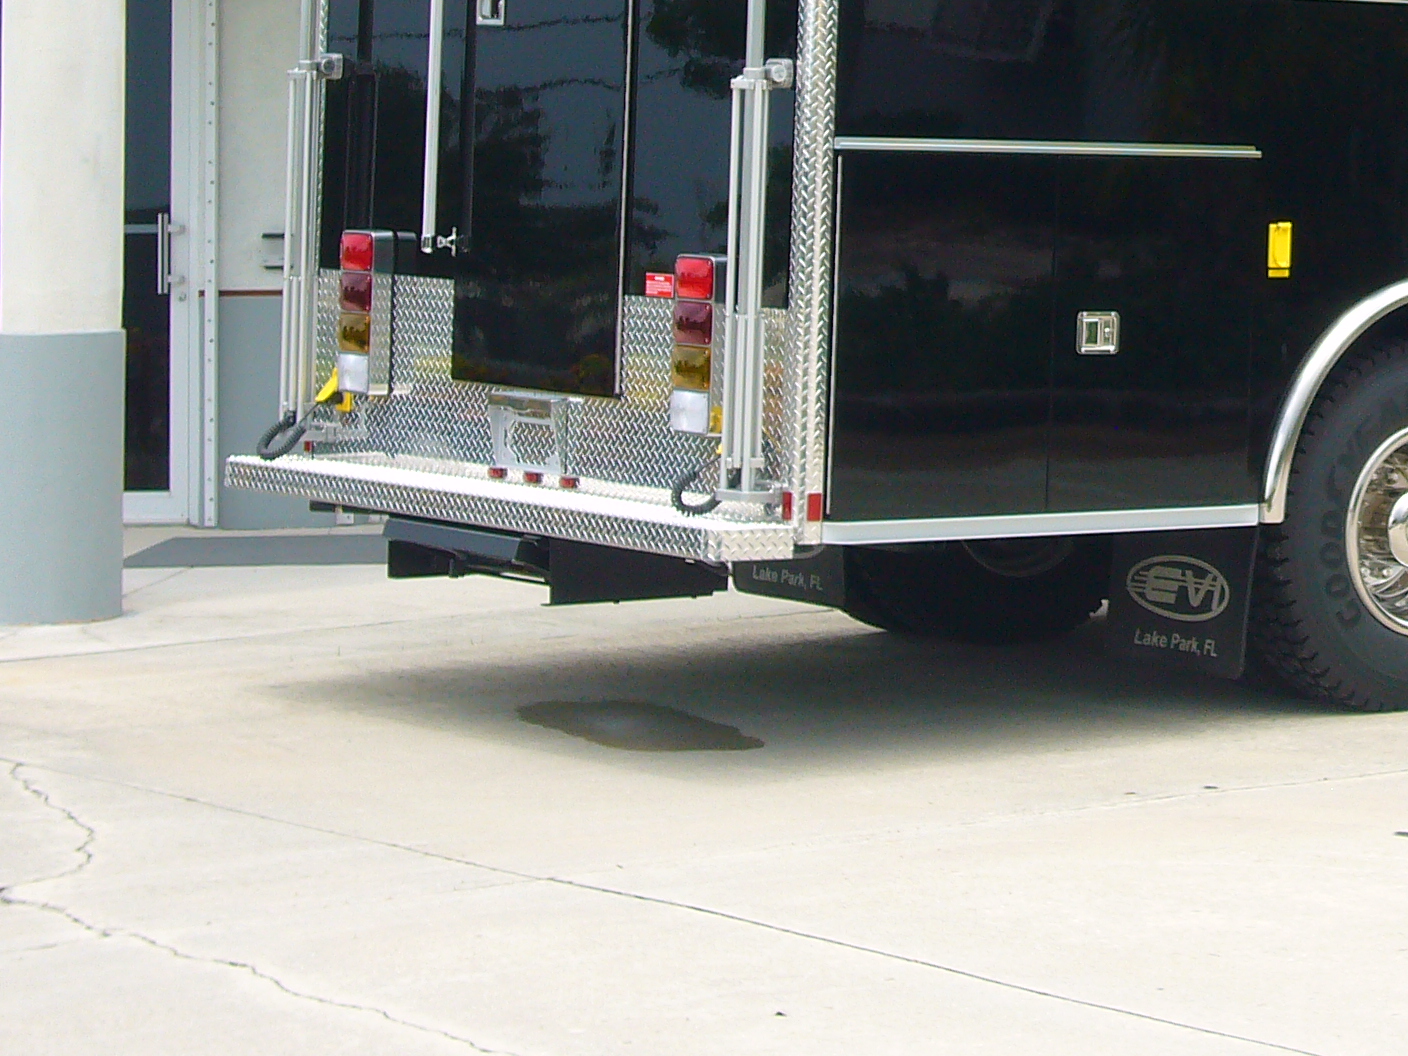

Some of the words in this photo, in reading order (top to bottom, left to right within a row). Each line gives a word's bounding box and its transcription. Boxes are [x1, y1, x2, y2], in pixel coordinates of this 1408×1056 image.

[753, 565, 778, 583] Lake
[781, 569, 807, 590] Park,
[809, 574, 823, 591] FL
[1133, 628, 1168, 648] Lake
[1170, 633, 1201, 656] Park,
[1203, 639, 1218, 657] FL
